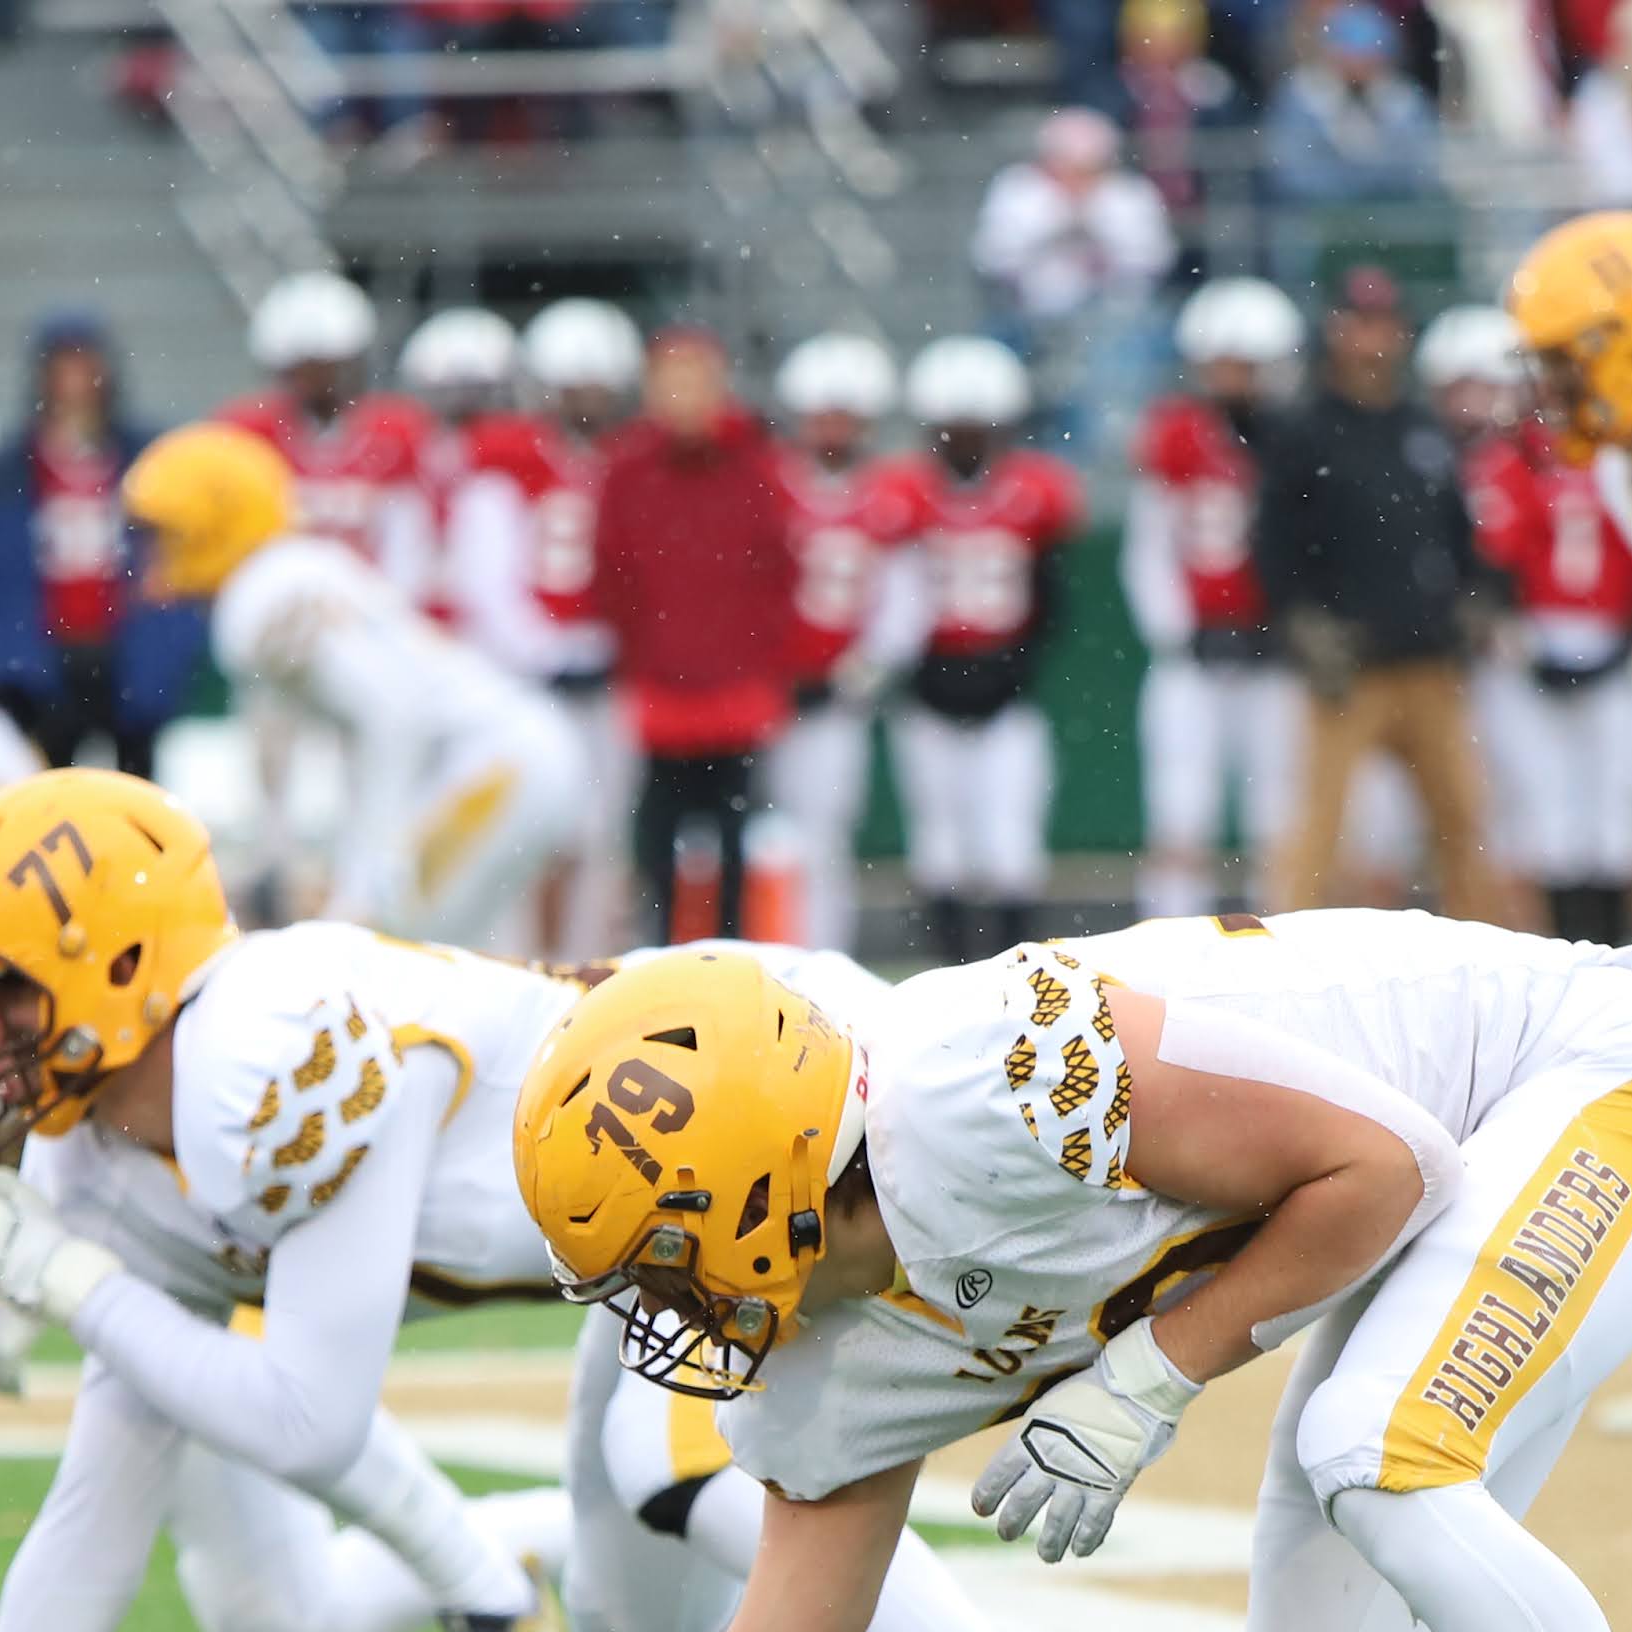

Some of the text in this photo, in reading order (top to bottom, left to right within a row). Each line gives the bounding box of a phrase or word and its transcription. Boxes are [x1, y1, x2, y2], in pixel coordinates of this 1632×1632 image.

[8, 820, 93, 926] 77
[585, 1057, 695, 1187] 79
[1423, 1149, 1631, 1432] HIGHLANDERS
